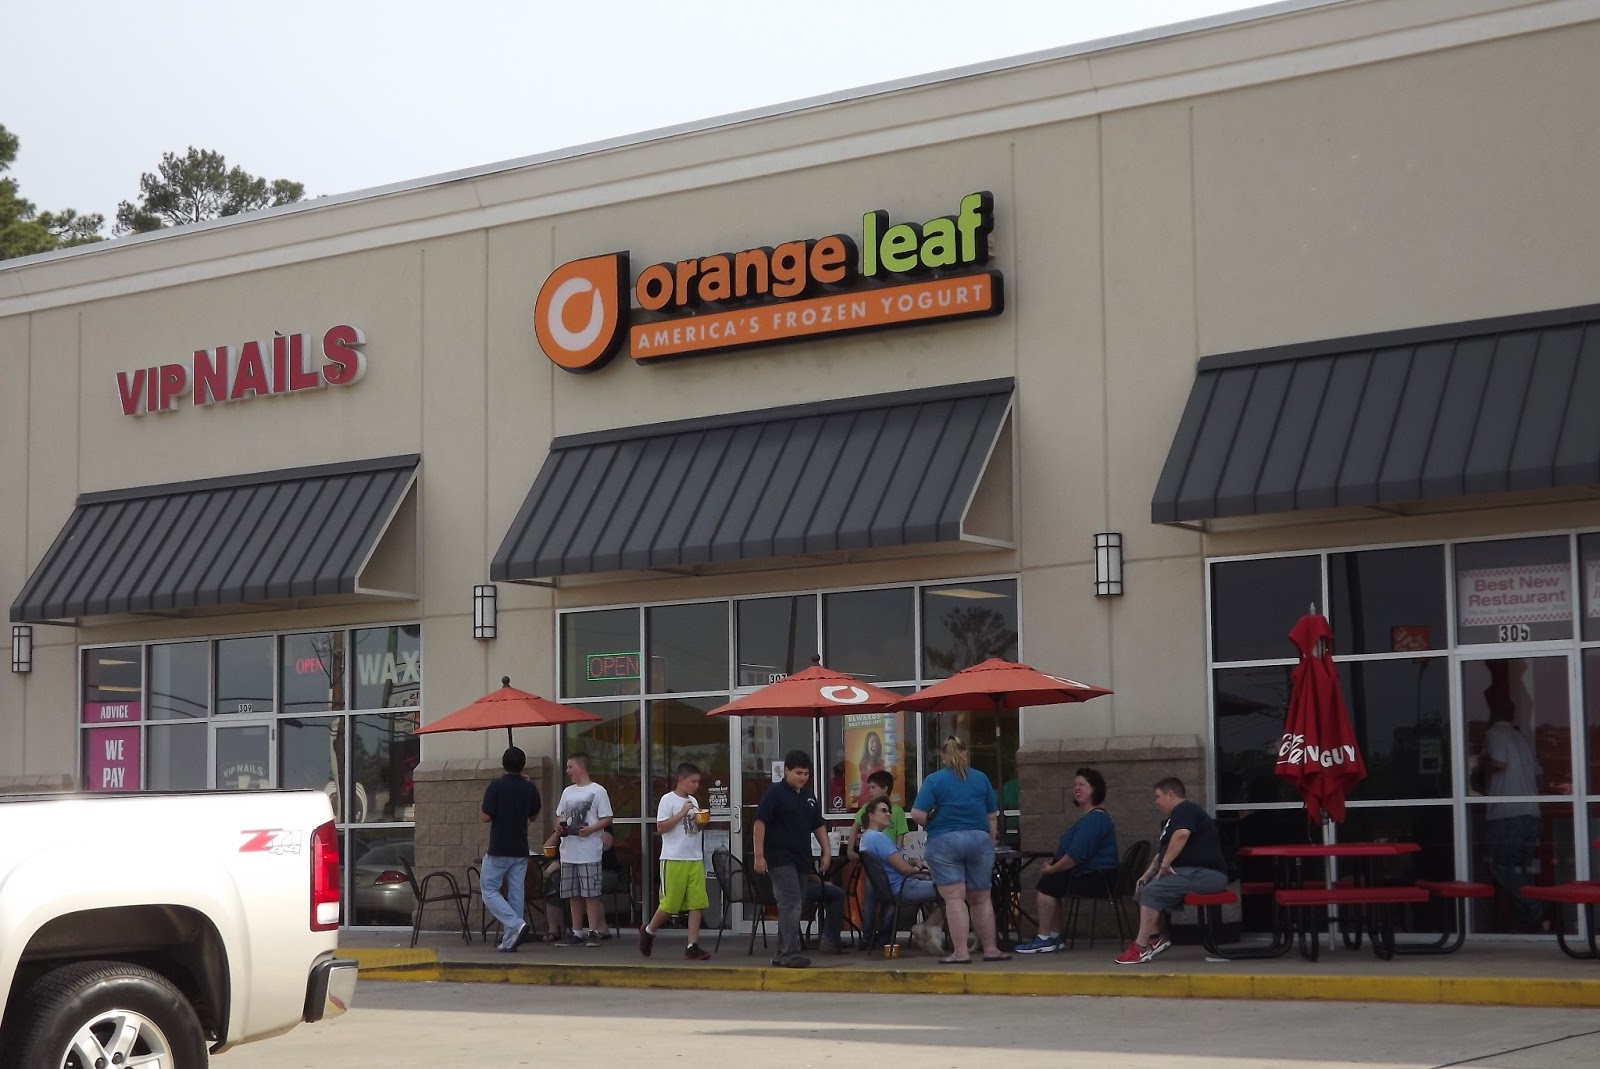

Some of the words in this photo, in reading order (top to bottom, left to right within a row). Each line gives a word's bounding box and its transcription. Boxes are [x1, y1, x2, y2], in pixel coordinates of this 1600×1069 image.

[636, 235, 850, 311] orange
[862, 193, 986, 277] leaf
[637, 316, 760, 350] AMERICA'S
[773, 301, 867, 331] FROZEN
[880, 284, 984, 313] YOGURT
[116, 363, 188, 415] VIP
[193, 325, 366, 405] NAILS
[1474, 578, 1514, 592] Best
[1520, 576, 1560, 589] New
[1468, 590, 1567, 608] Restaurant
[1500, 624, 1529, 641] 305
[295, 657, 325, 674] OPEN
[357, 650, 420, 686] WAX
[590, 655, 640, 678] OPEN
[100, 705, 129, 719] ADVICE
[239, 704, 253, 713] 309
[847, 714, 881, 722] REWARDS
[105, 739, 124, 761] WE
[102, 767, 126, 788] PAY
[223, 766, 236, 777] VIP
[236, 763, 264, 777] NAILS
[239, 828, 302, 853] Z71
